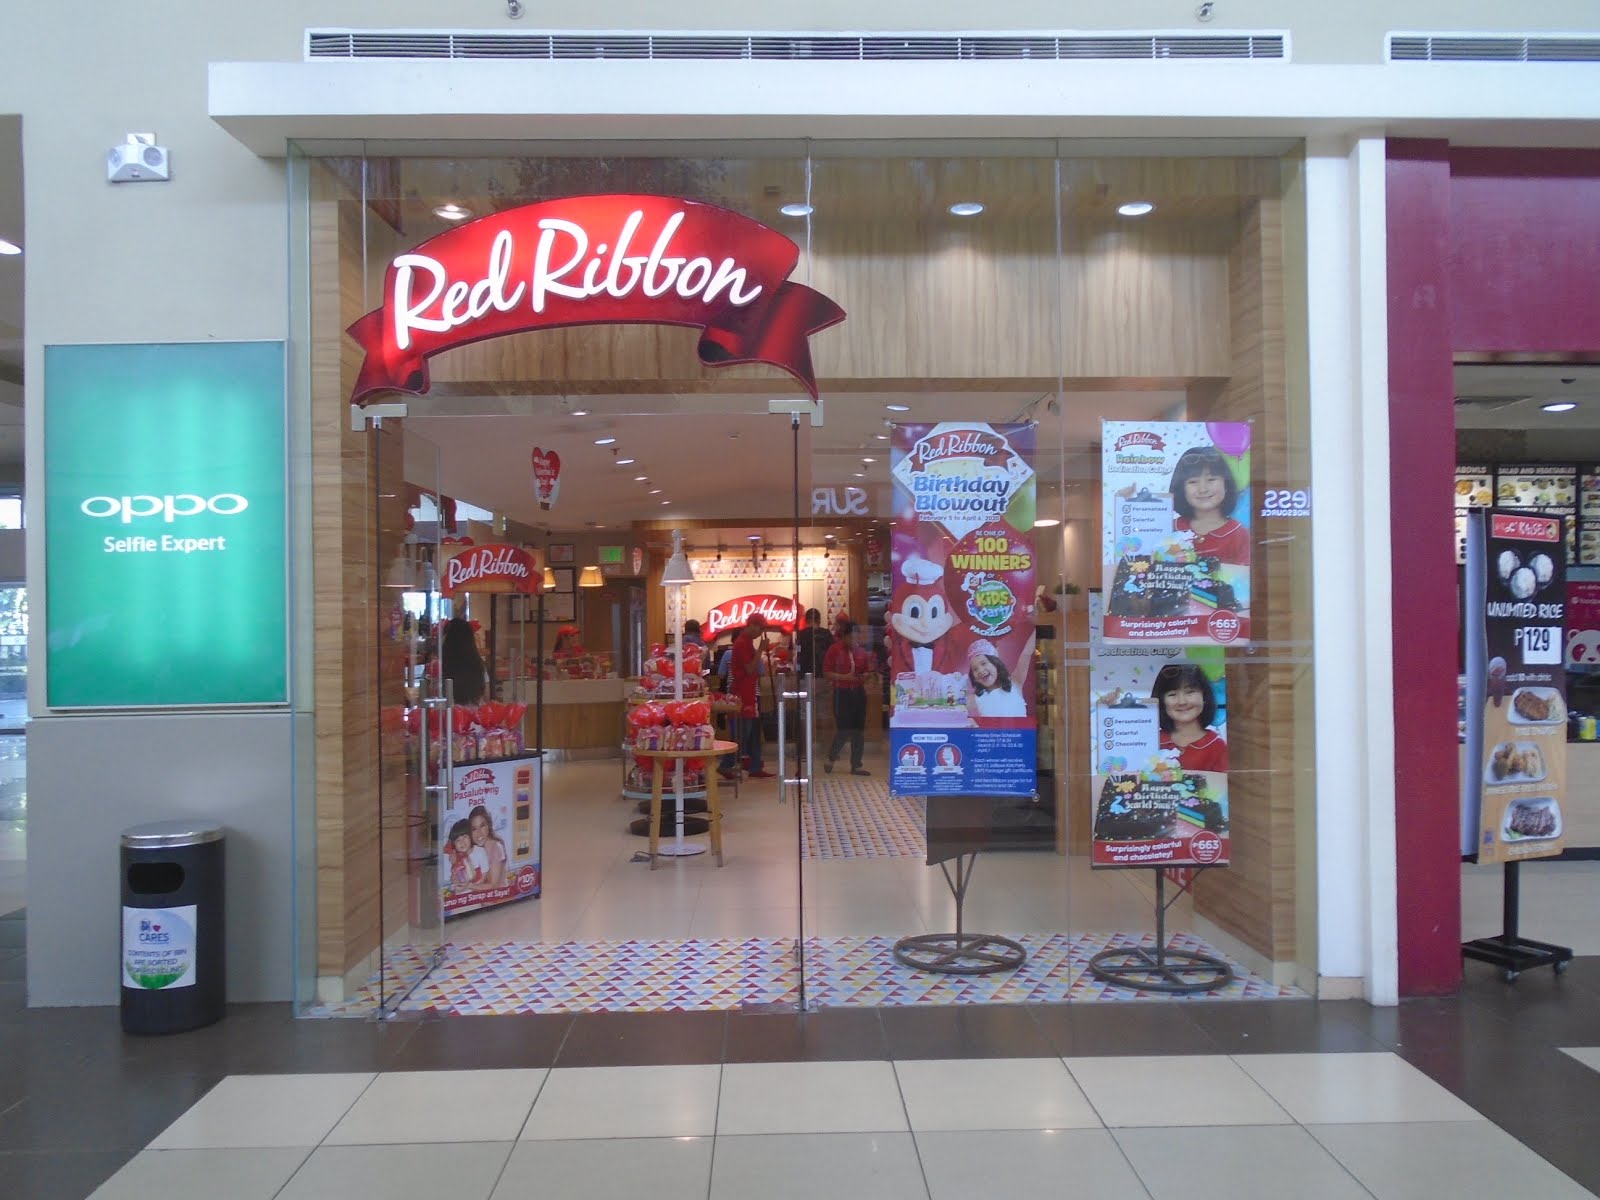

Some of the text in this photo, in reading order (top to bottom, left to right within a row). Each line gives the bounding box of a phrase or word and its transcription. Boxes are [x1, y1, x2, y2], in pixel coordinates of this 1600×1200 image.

[393, 209, 763, 350] Red Ribbon
[918, 433, 998, 463] Red Ribbon
[1116, 453, 1166, 465] Rainbow
[913, 475, 1010, 497] Birthday
[914, 494, 1008, 512] Blowout
[104, 534, 226, 553] Selfie Expert
[975, 537, 1008, 553] 100
[449, 548, 529, 588] Red Ribbon
[950, 554, 1032, 571] WINNERS
[709, 604, 740, 633] Red
[1487, 602, 1564, 619] UNLIMITED RICE
[1120, 618, 1198, 630] Surprisingly colorful
[1145, 629, 1190, 638] chocolatey!
[468, 797, 486, 807] Pack
[1105, 841, 1183, 854] Surprisingly colorful
[1129, 852, 1174, 861] chocolatey!
